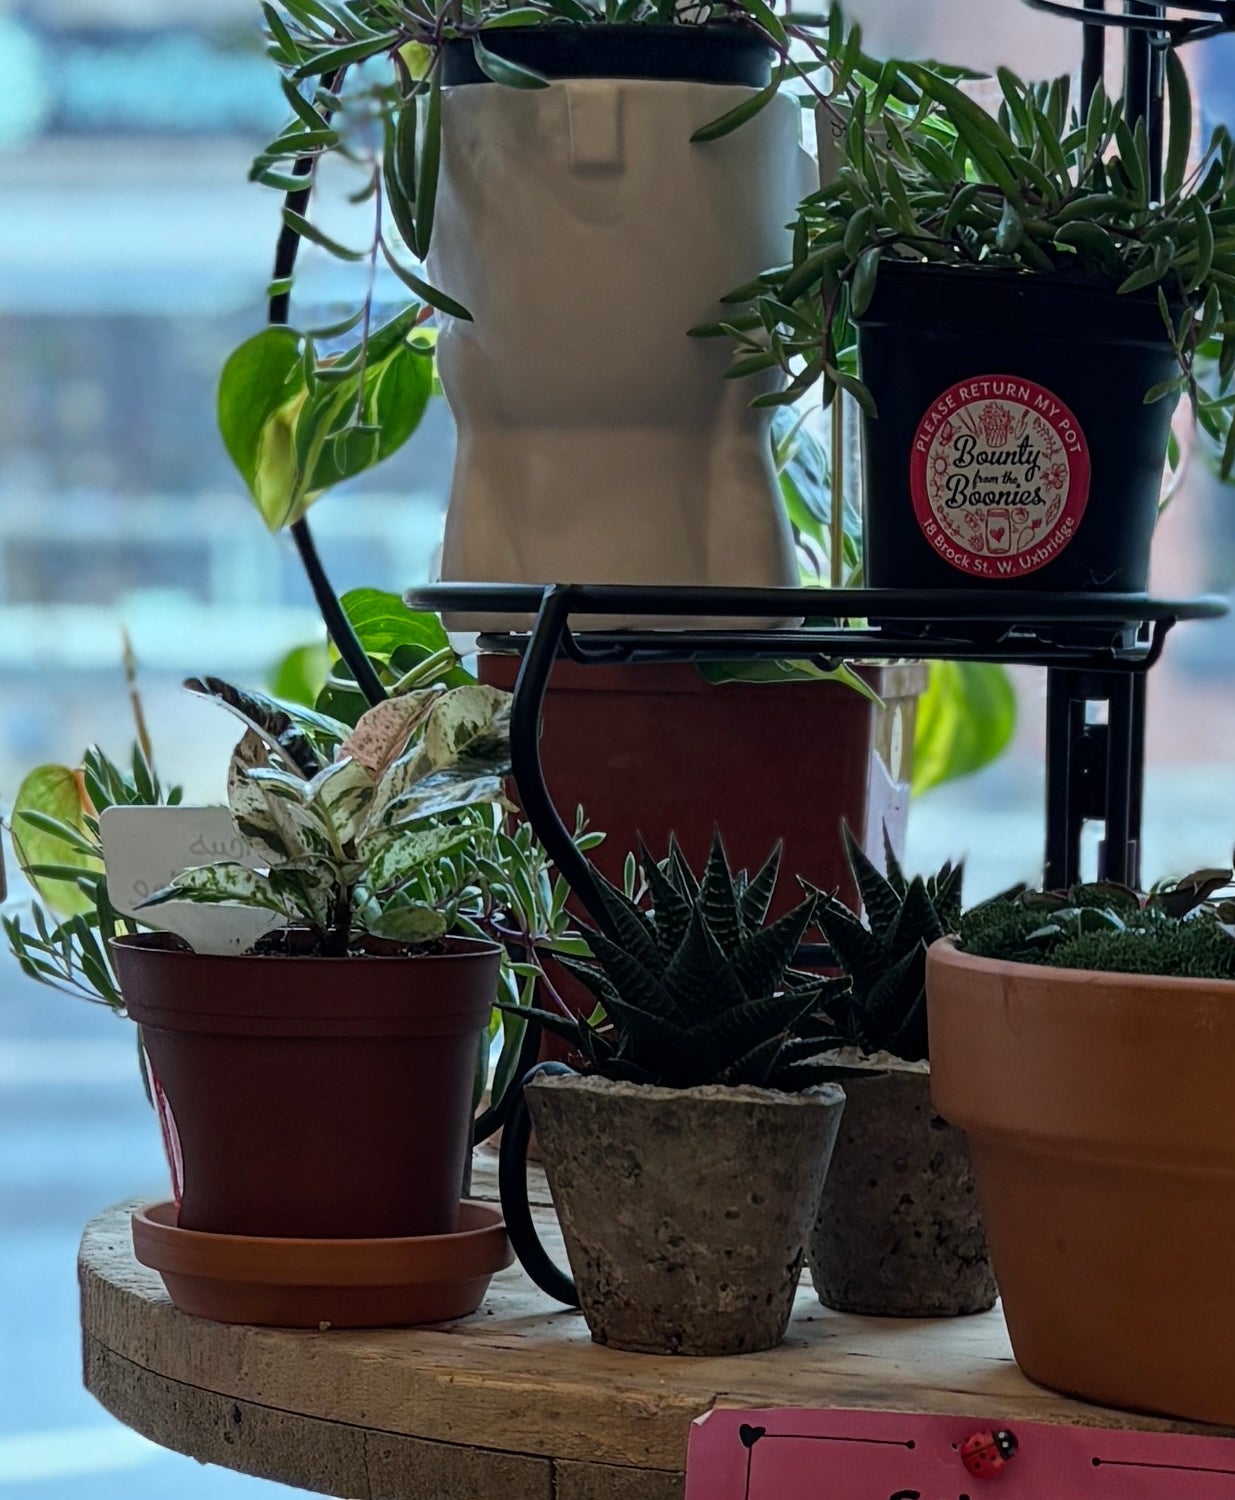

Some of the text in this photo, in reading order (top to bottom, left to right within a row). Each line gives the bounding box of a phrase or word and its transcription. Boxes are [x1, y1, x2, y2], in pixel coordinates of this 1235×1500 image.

[917, 382, 1081, 453] PLEASE RETURN MY POT
[953, 435, 1041, 482] Bounty
[973, 469, 1018, 489] from the
[945, 473, 1046, 509] Boonies
[923, 519, 935, 535] 18
[935, 534, 969, 568] Brock
[997, 561, 1016, 573] W.
[1019, 517, 1075, 569] Uxbridge
